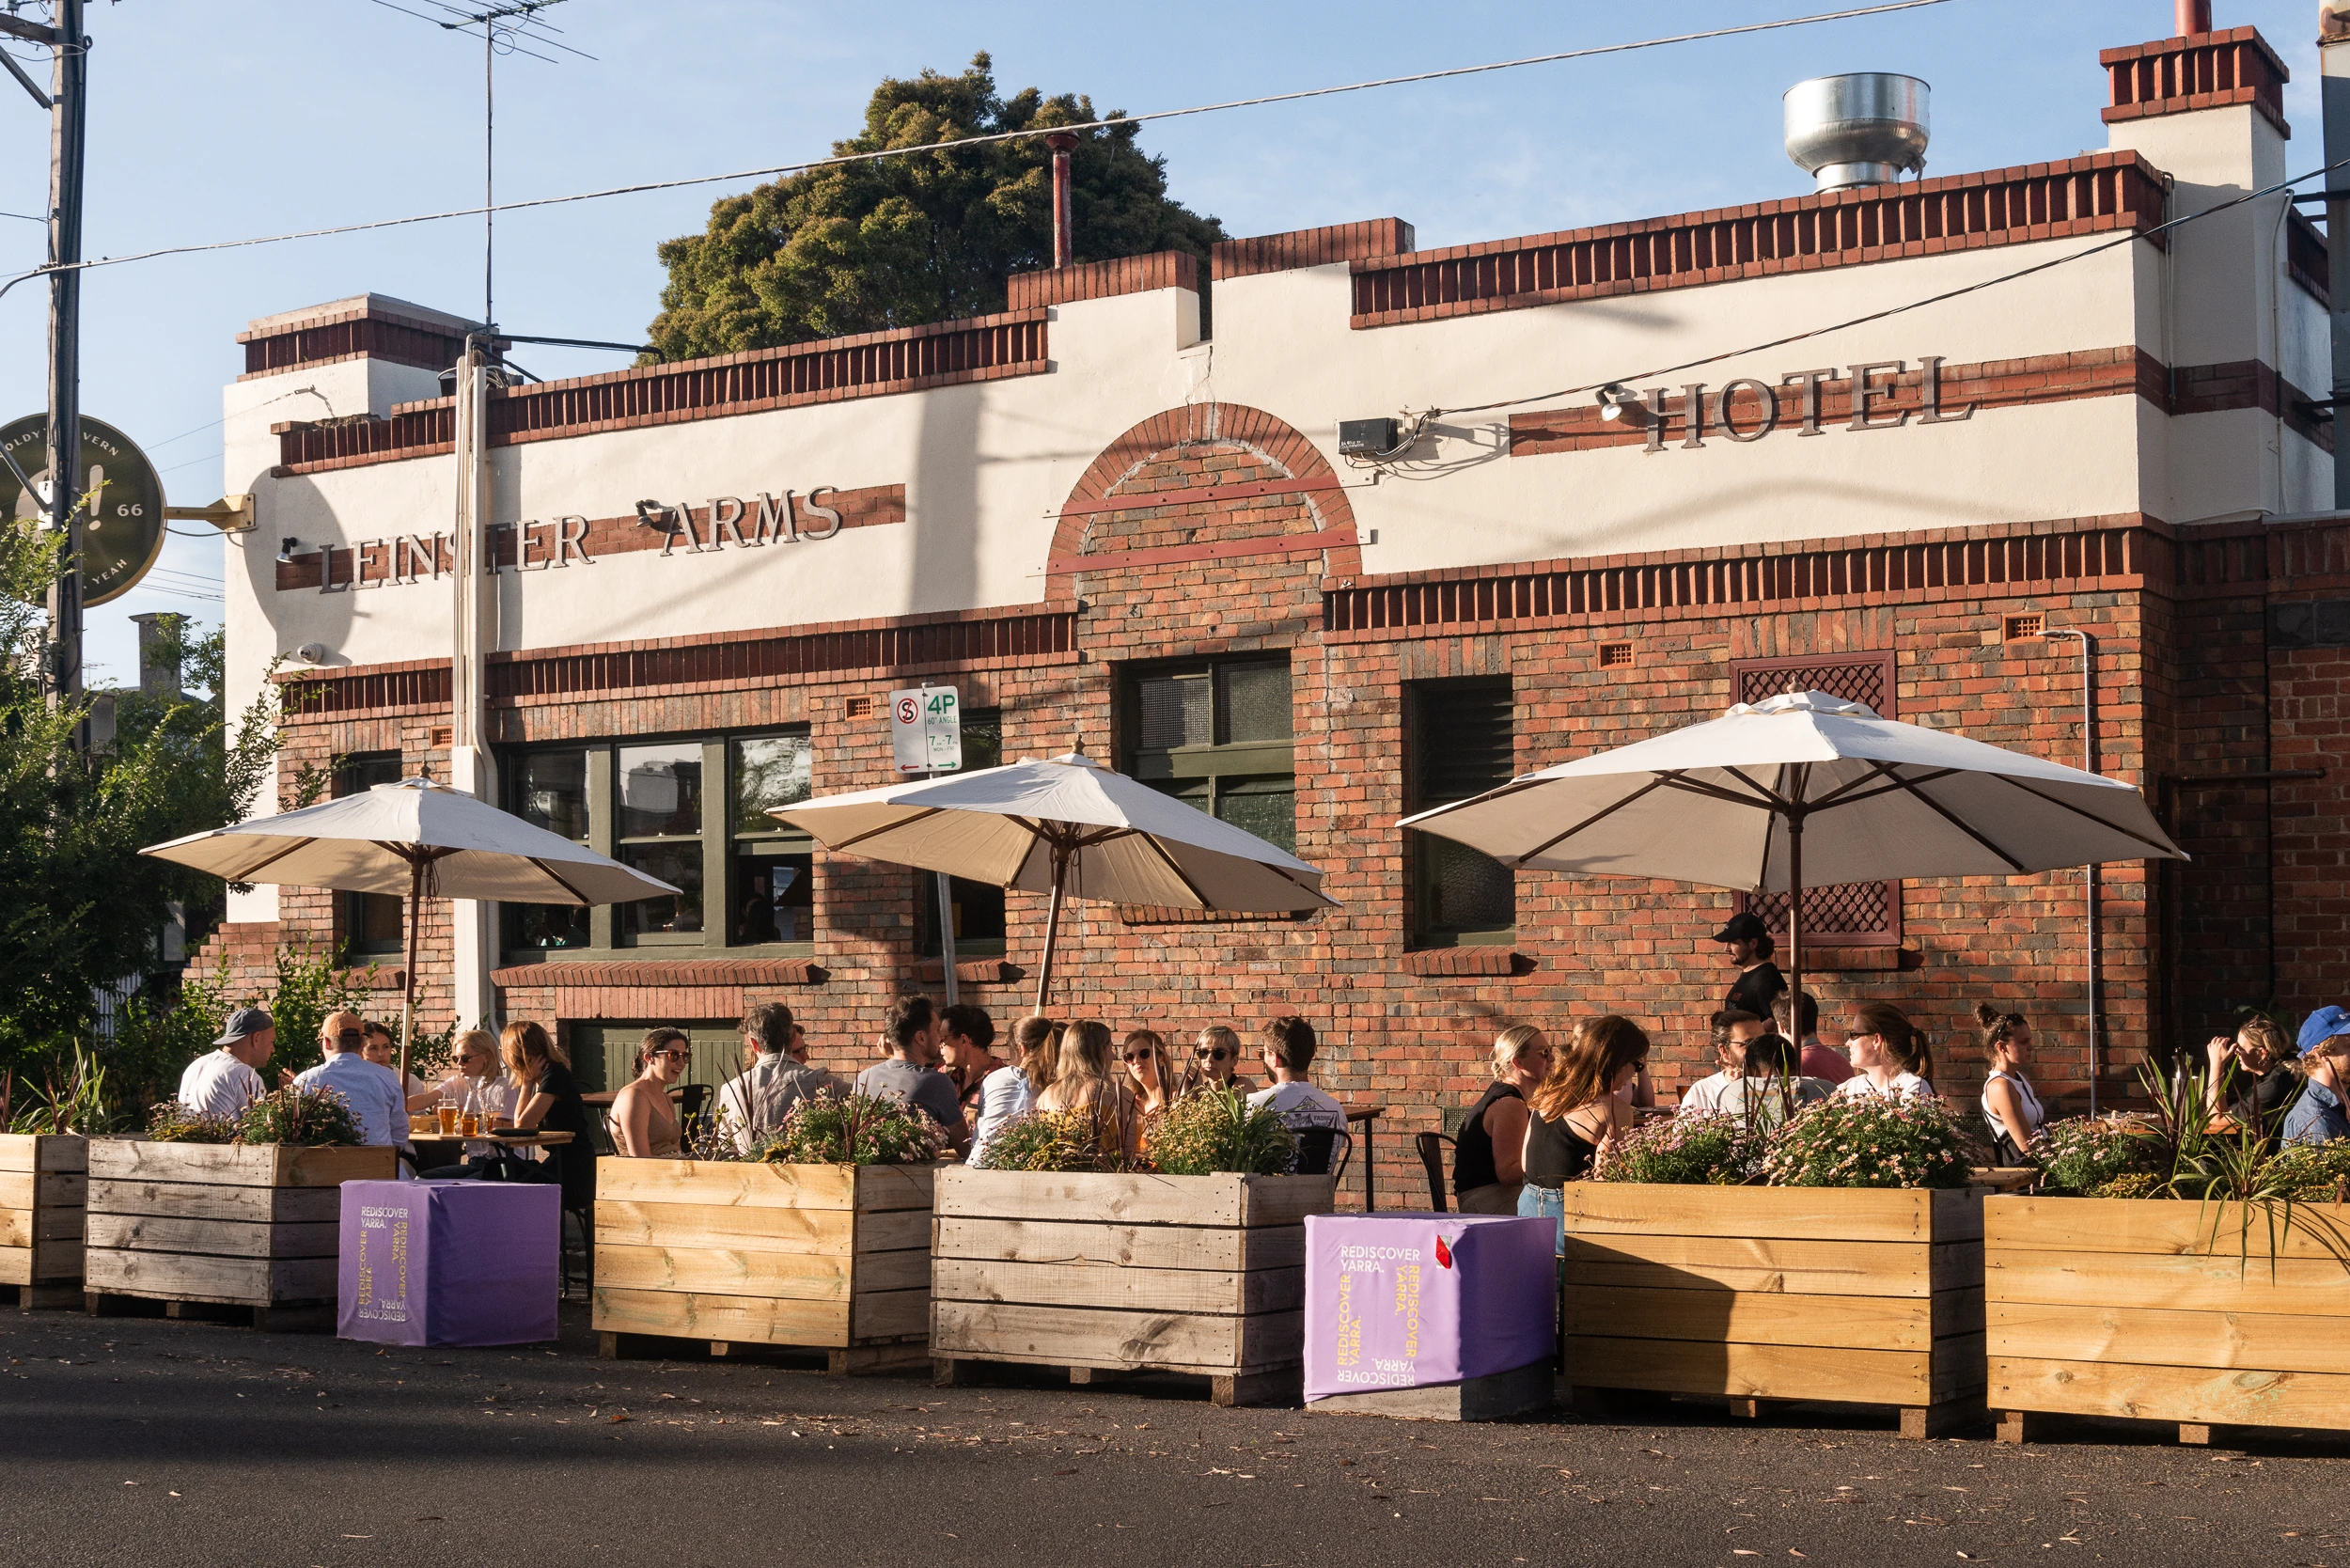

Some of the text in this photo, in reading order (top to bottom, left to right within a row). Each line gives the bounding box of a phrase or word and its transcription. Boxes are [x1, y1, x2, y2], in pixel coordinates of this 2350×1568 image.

[1642, 355, 1974, 453] HOTEL
[83, 431, 119, 457] VERN
[117, 503, 144, 517] 66
[660, 484, 839, 557] ARMS
[91, 557, 128, 586] YEAH
[927, 694, 956, 714] 4P
[939, 715, 957, 725] ANGLE
[361, 1206, 408, 1219] REDISCOVER
[361, 1218, 386, 1229] YARRA.
[399, 1222, 407, 1298] REDISCOVER
[1340, 1246, 1420, 1262] REDISCOVER
[1340, 1260, 1385, 1273] YARRA.
[1394, 1265, 1407, 1317] YARRA.
[378, 1298, 406, 1309] YARRA.
[1404, 1265, 1420, 1358] REDISCOVER
[358, 1308, 406, 1322] REDISCOVER
[1337, 1274, 1351, 1366] REDISCOVER
[1347, 1314, 1362, 1366] YARRA.
[1371, 1357, 1416, 1372] YARRA.
[1337, 1369, 1415, 1387] REDISCOVER
